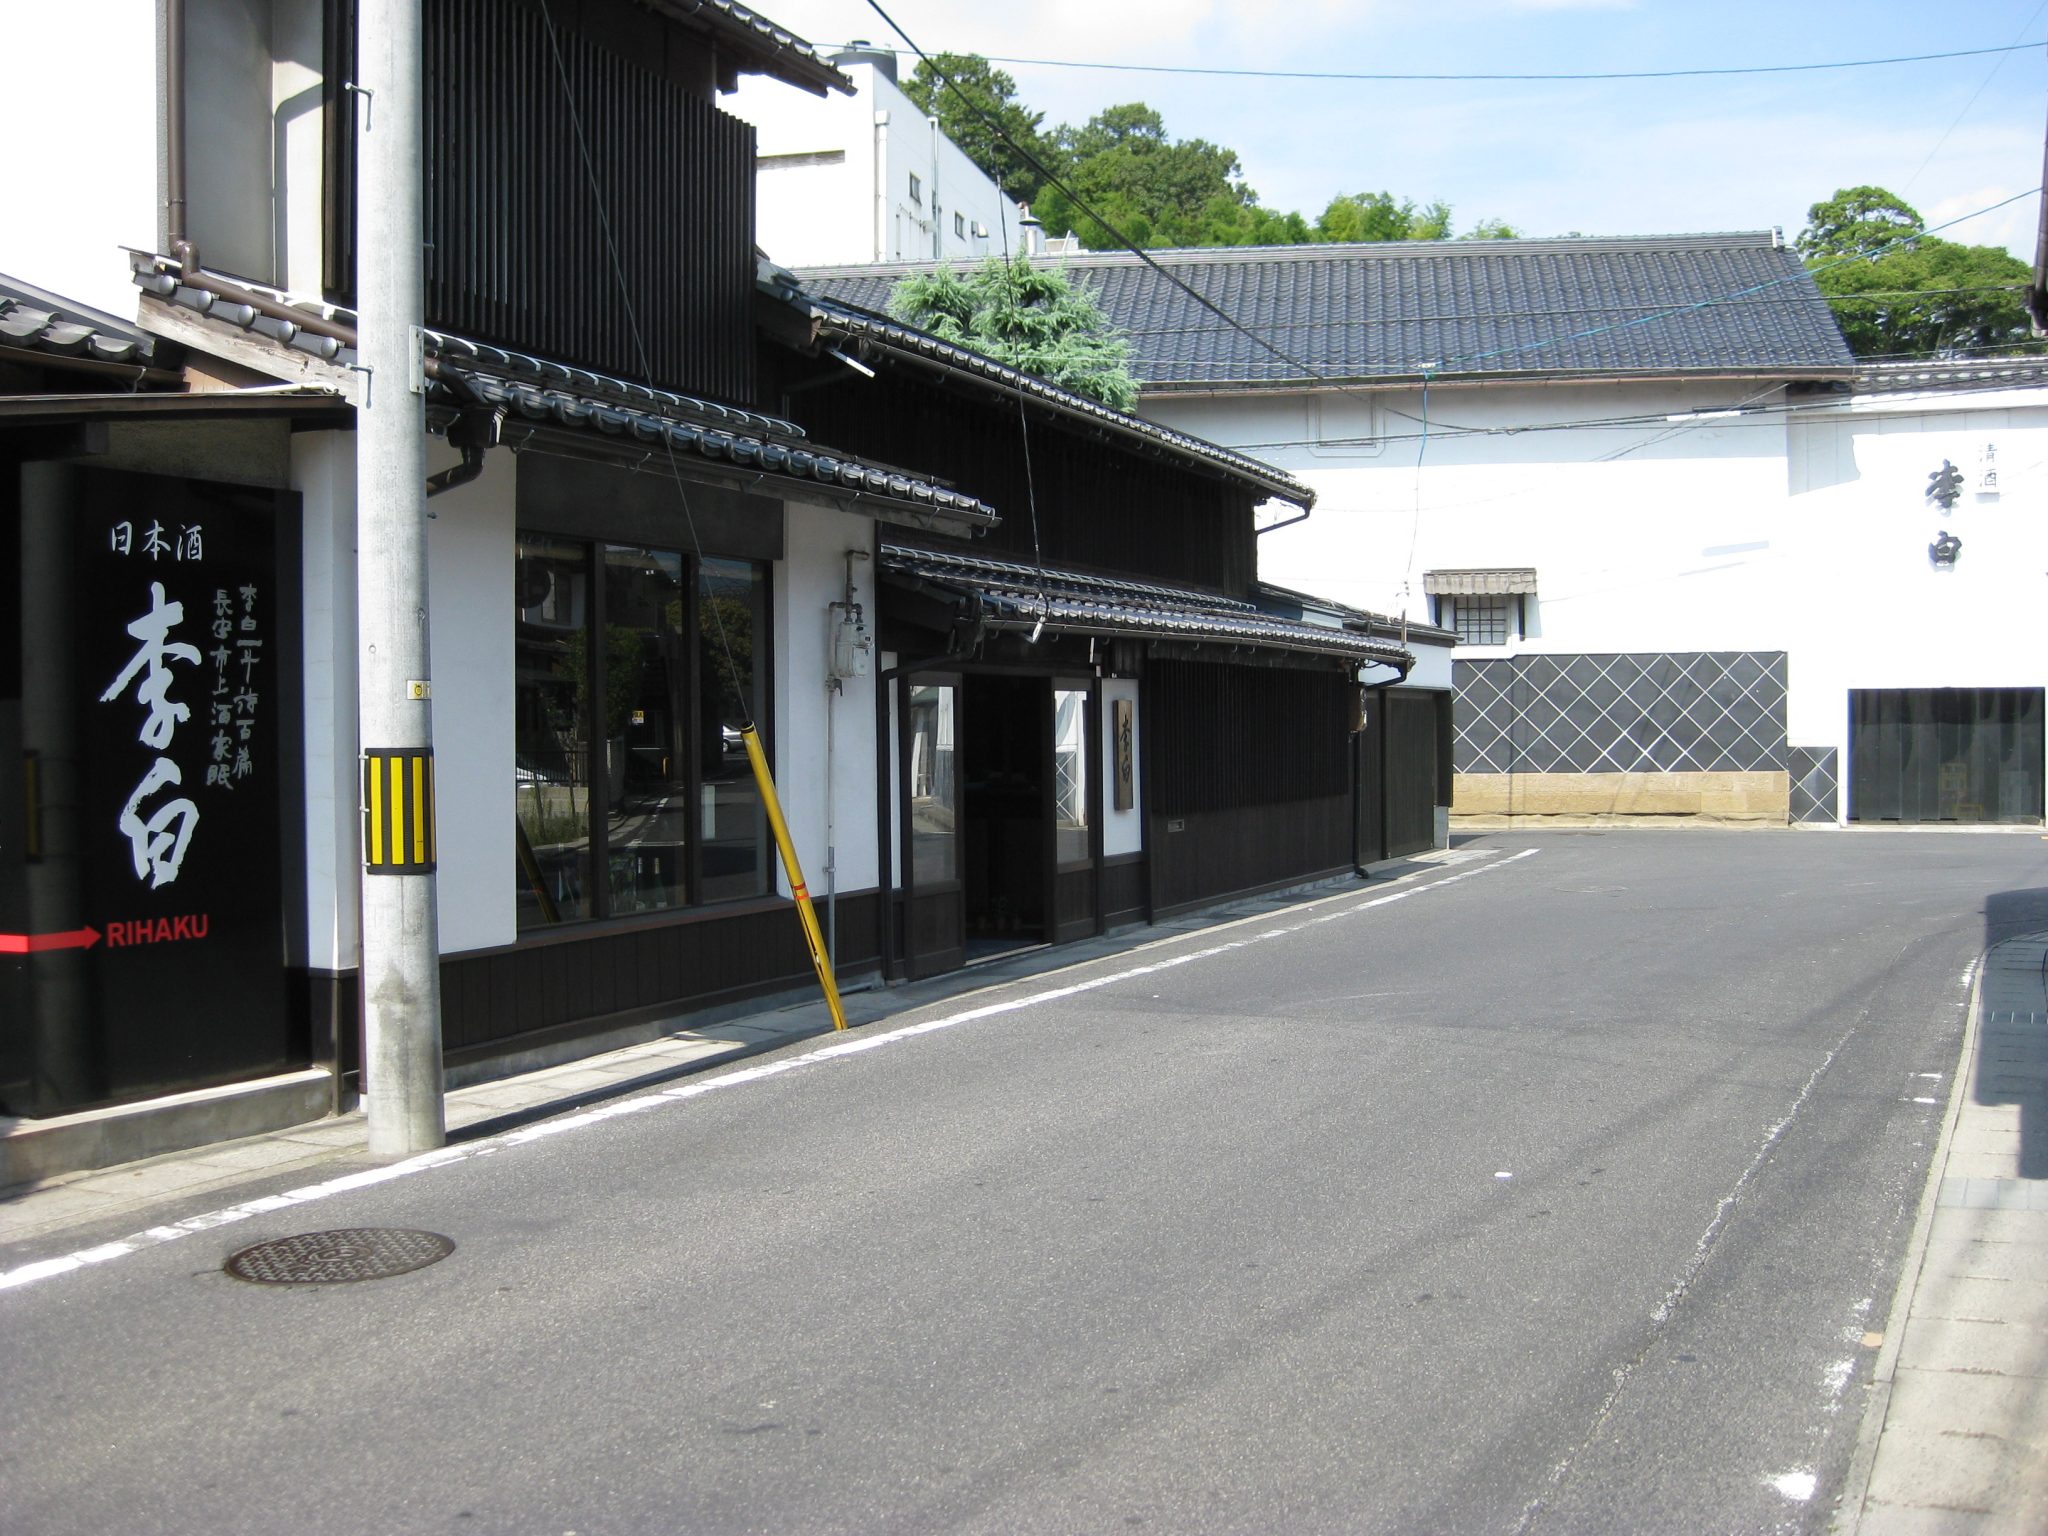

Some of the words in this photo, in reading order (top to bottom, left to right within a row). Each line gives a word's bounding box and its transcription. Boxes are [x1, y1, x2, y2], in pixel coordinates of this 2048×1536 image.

[111, 519, 203, 562] 日本酒
[1924, 458, 1965, 563] 李白
[99, 581, 202, 889] 李白
[106, 913, 208, 948] RIHAKU
